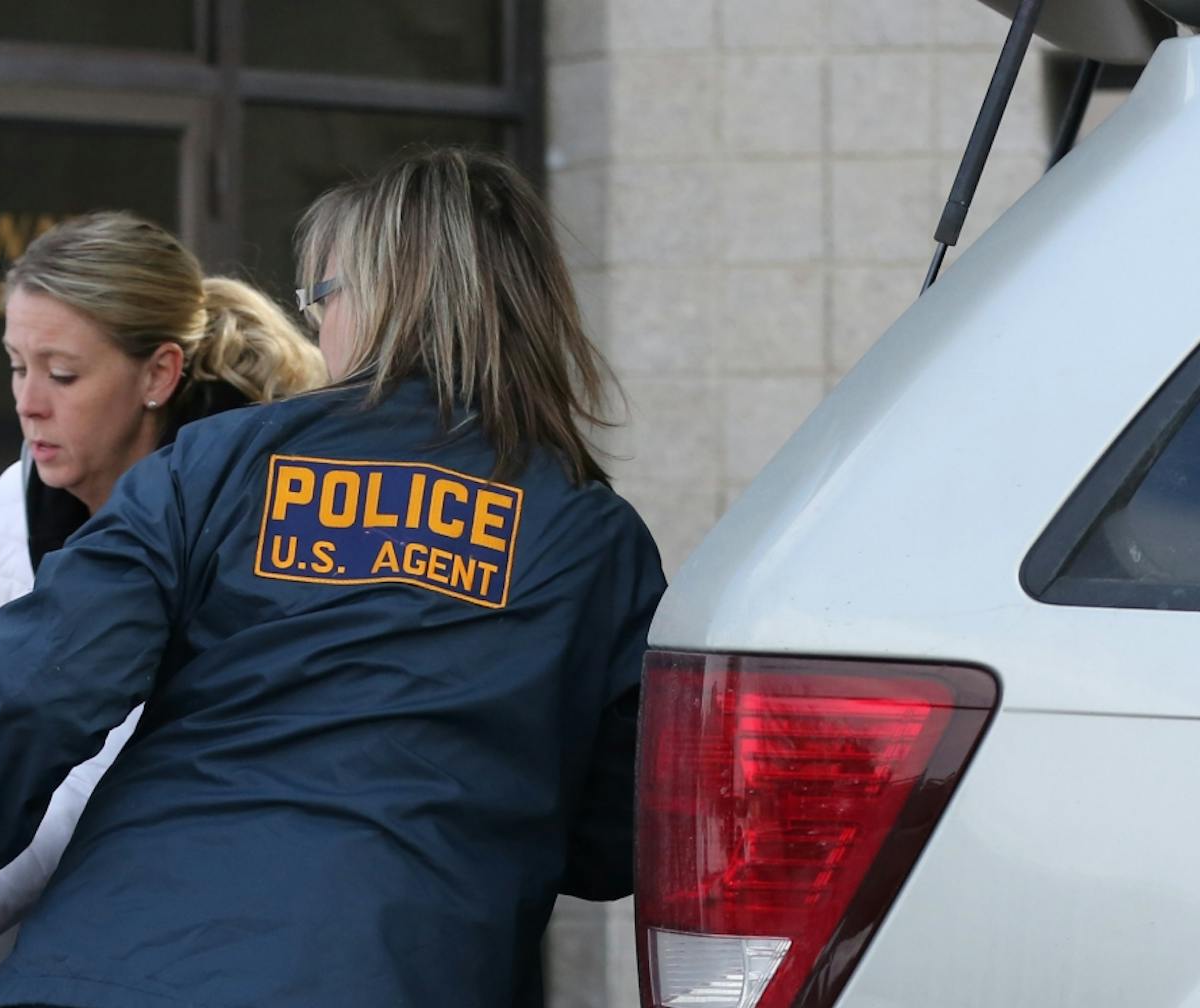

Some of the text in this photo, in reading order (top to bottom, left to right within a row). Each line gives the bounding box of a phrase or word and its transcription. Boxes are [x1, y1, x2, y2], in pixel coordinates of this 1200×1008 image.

[271, 465, 513, 552] POLICE
[270, 535, 498, 596] U.S. AGENT
